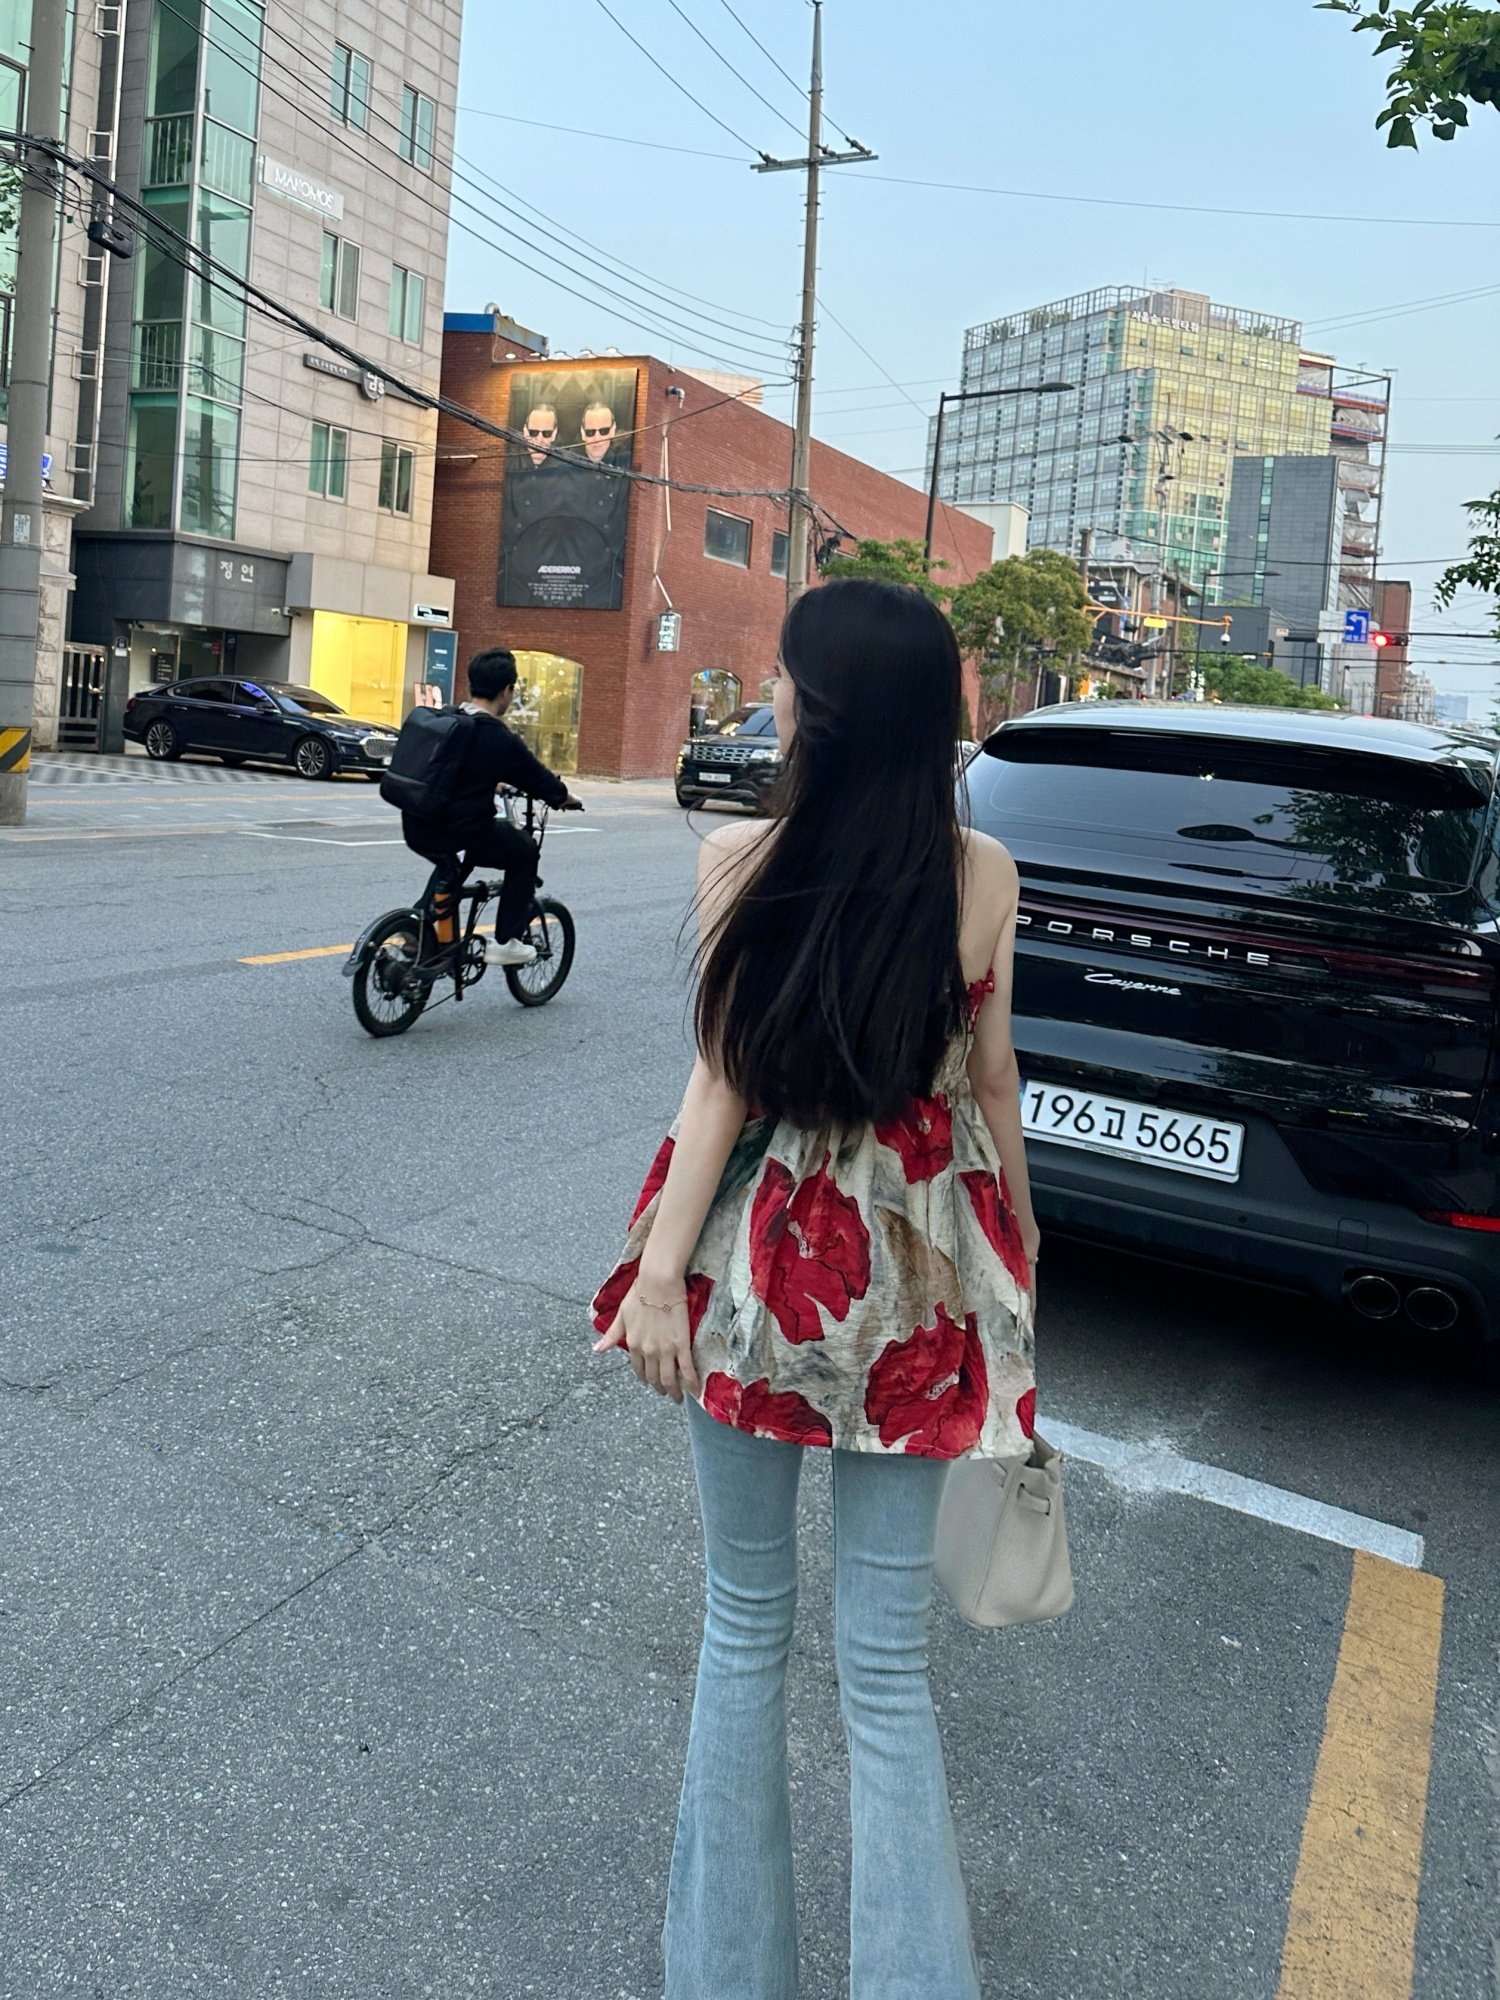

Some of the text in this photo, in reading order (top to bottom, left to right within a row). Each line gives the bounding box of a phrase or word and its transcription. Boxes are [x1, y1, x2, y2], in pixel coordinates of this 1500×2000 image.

[1016, 914, 1270, 966] PORSCHE
[1084, 968, 1182, 996] Cayenne
[1030, 1090, 1232, 1164] 196고 5665
